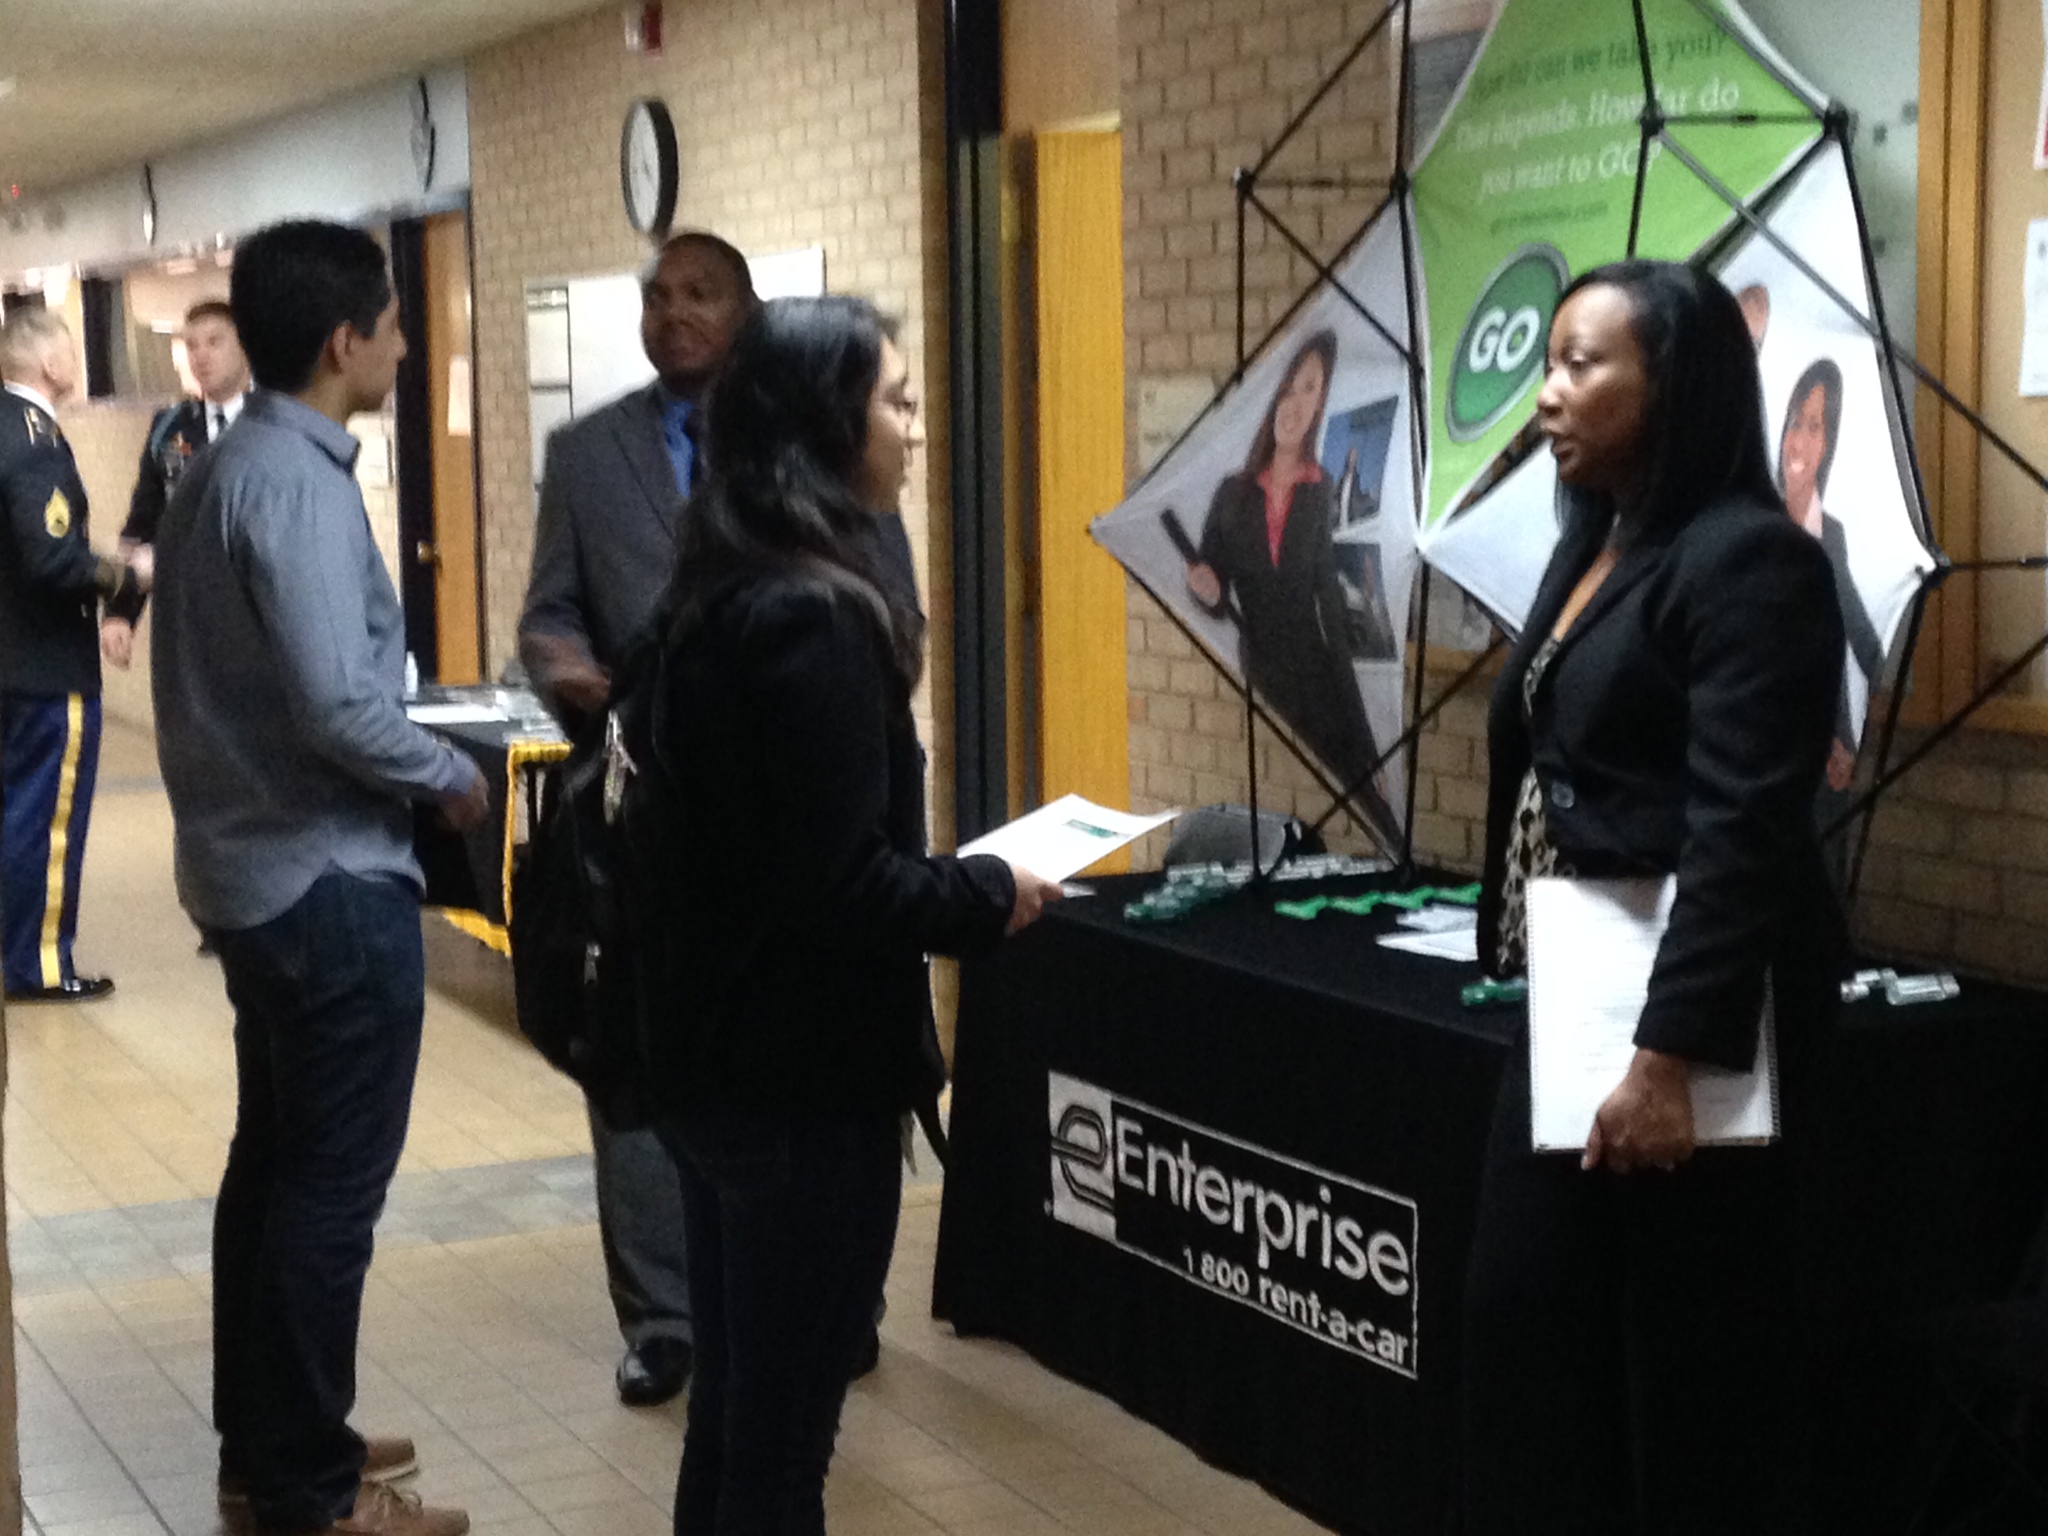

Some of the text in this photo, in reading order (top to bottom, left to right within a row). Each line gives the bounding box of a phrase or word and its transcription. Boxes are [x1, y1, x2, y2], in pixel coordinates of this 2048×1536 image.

[1608, 37, 1657, 69] tae
[1698, 74, 1741, 112] do
[1567, 153, 1591, 184] to
[1468, 306, 1541, 373] GO
[1116, 1115, 1411, 1297] Enterprise
[1183, 1245, 1409, 1365] 1 800 rent-a-car
